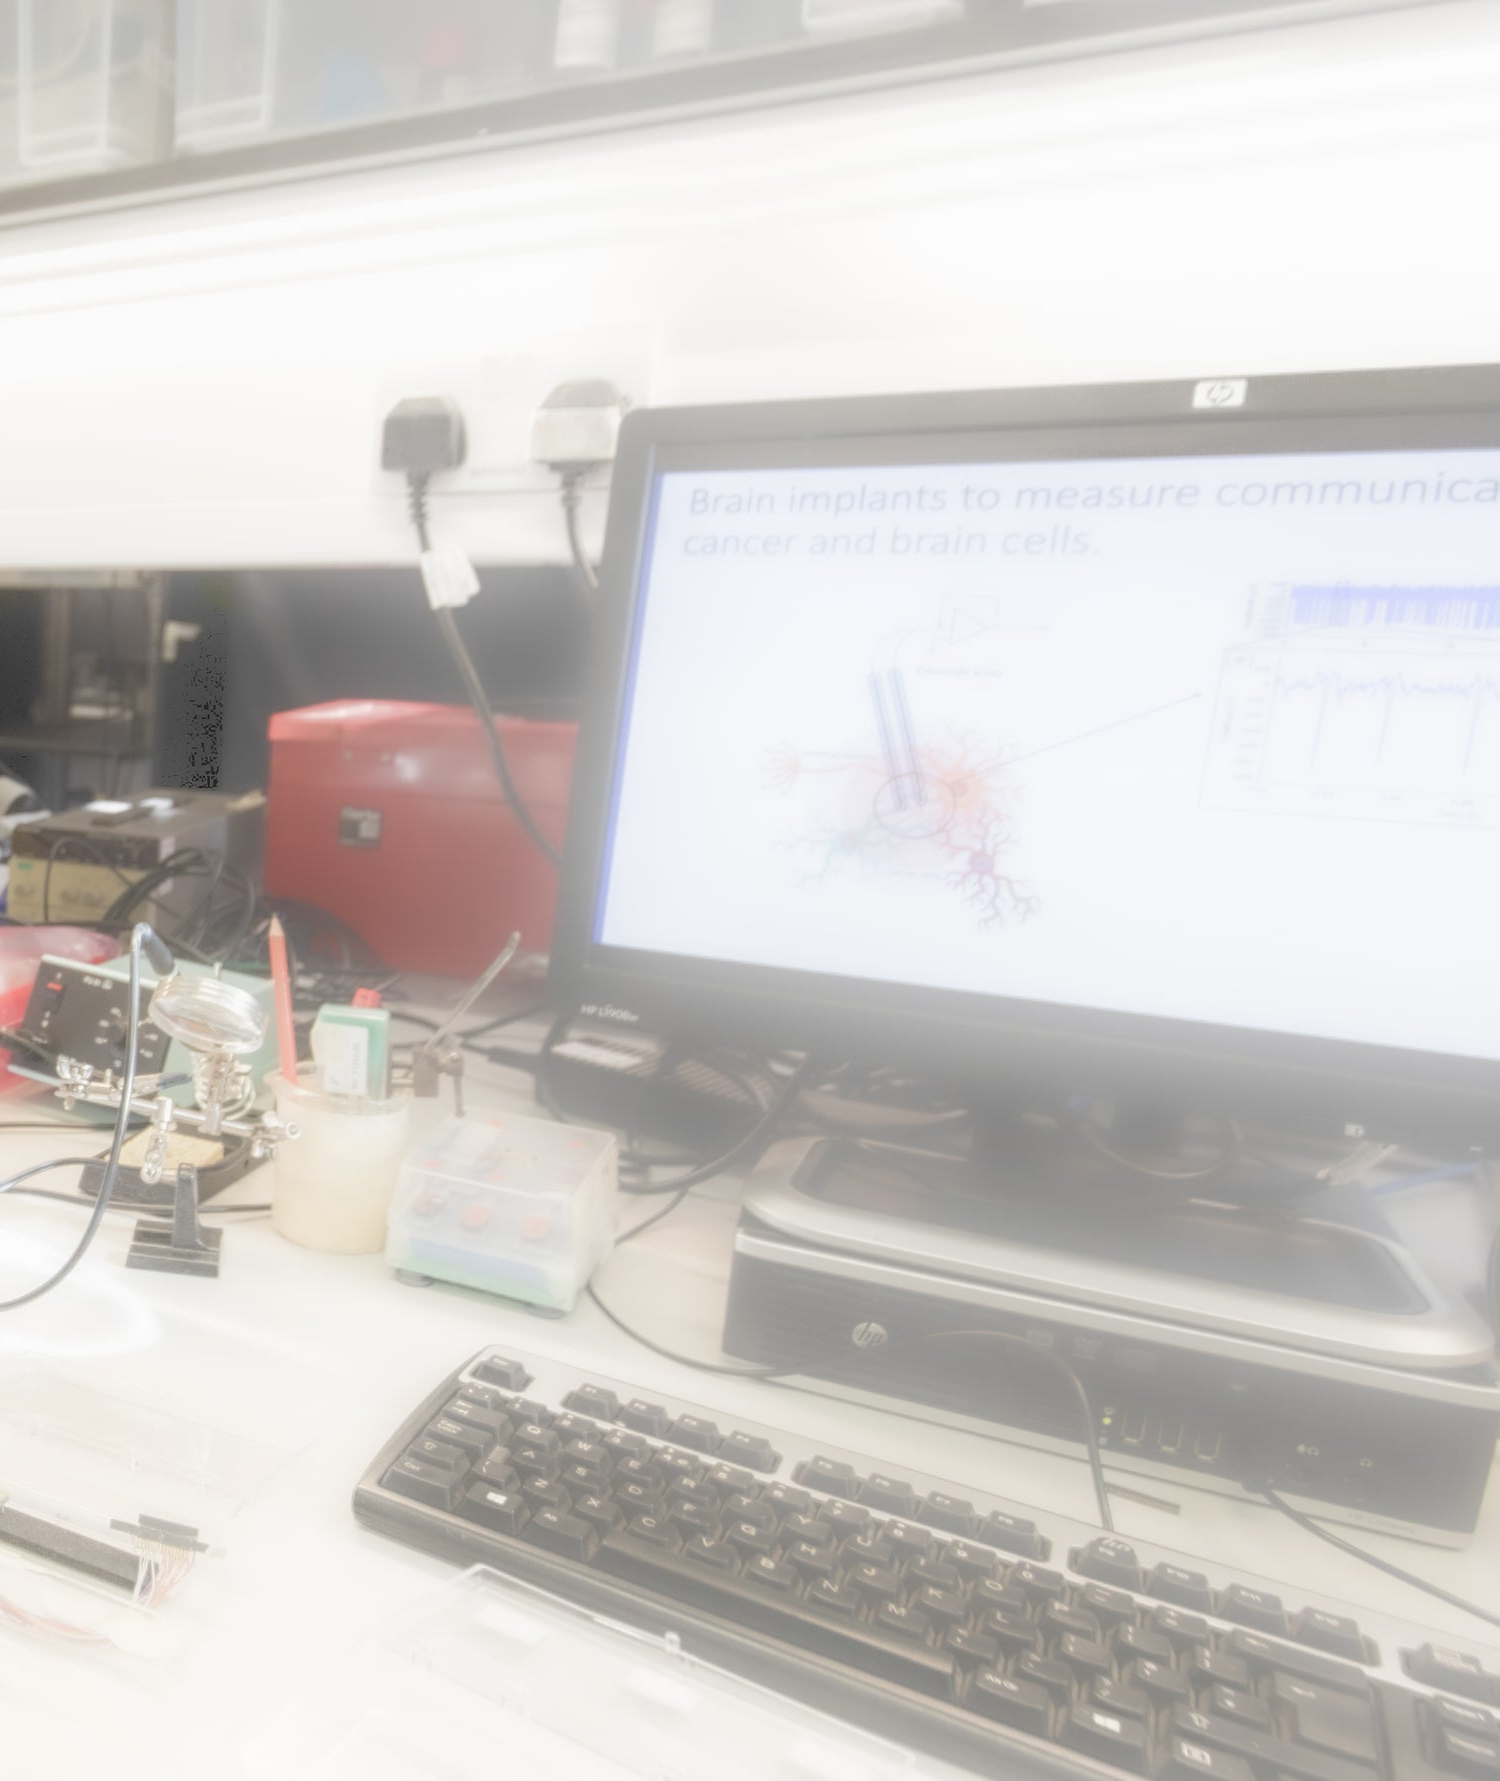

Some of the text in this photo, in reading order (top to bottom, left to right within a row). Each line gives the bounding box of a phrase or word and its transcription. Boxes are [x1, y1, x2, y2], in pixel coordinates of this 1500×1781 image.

[690, 487, 775, 516] Brain
[788, 483, 947, 516] implants
[962, 484, 1002, 511] to
[1016, 480, 1200, 511] measure
[683, 523, 1102, 556] cancer and brain cells.
[854, 1320, 886, 1349] hp
